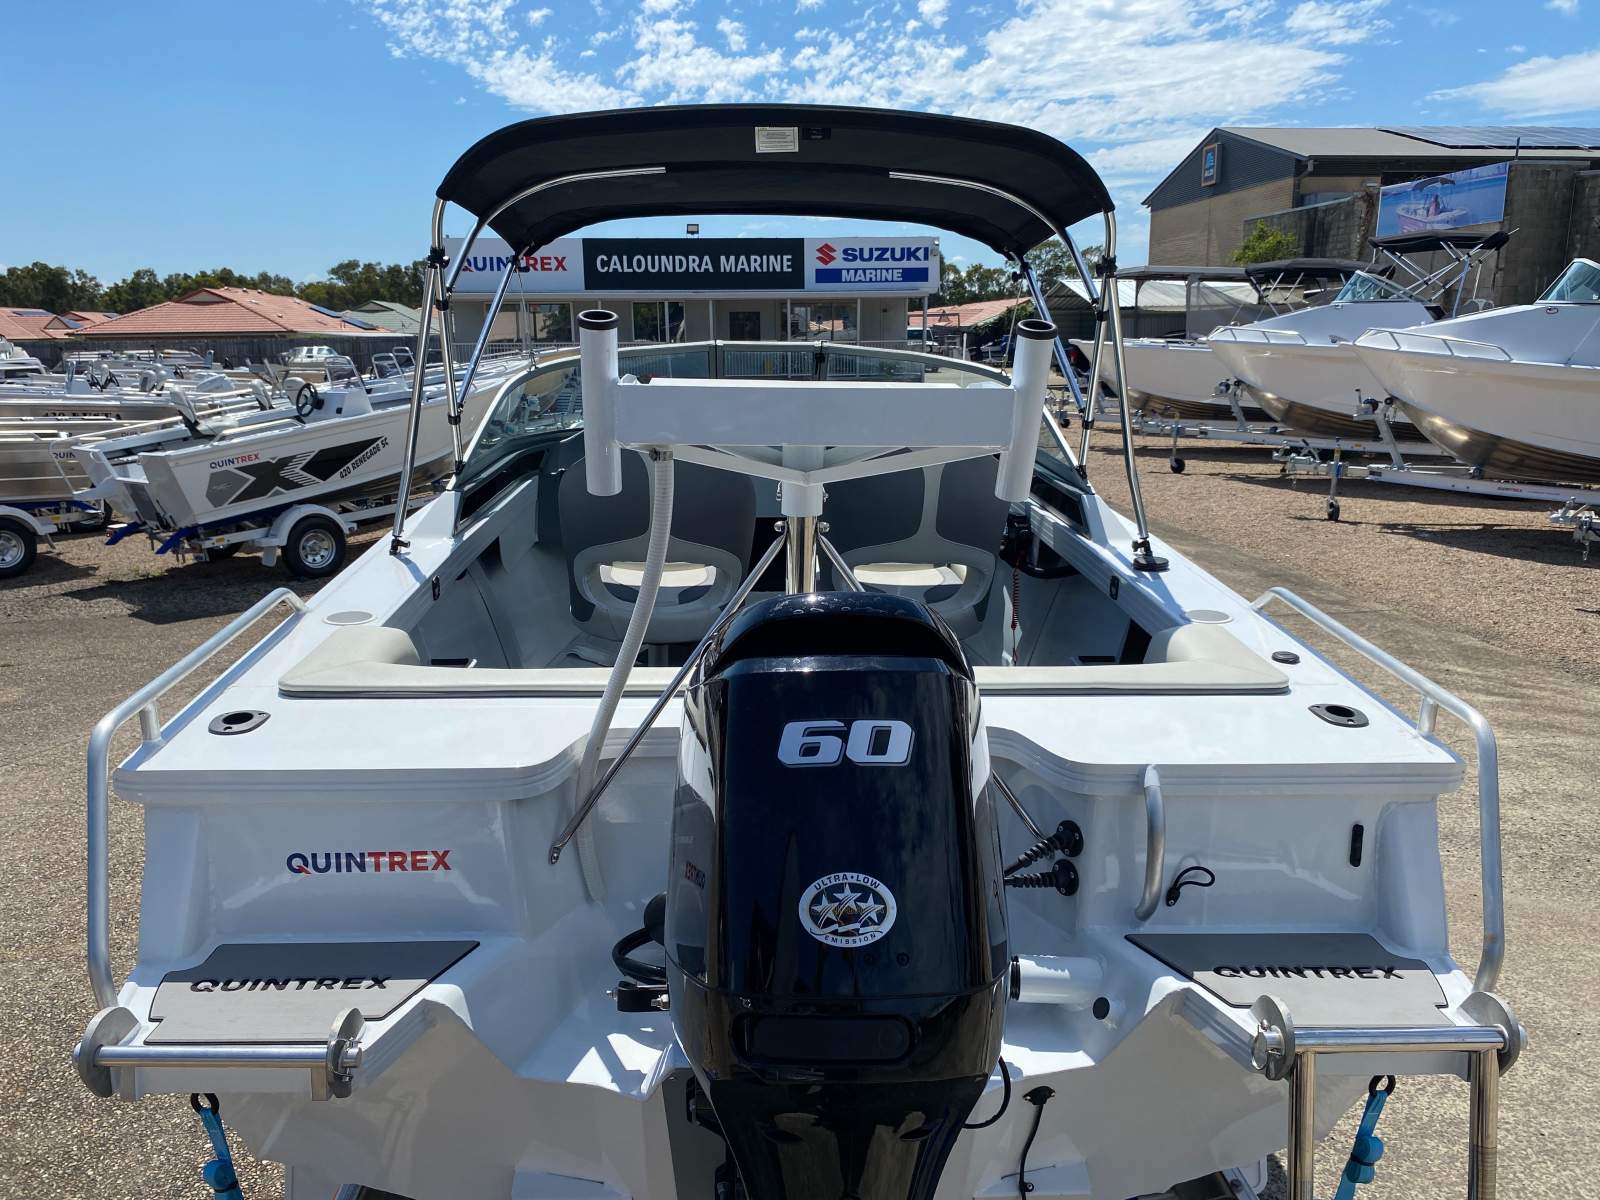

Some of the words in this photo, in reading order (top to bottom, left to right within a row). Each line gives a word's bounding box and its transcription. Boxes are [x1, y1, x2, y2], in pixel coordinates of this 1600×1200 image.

[841, 246, 929, 262] SUZUKI
[596, 254, 714, 273] CALOUNDRA
[719, 254, 793, 273] MARINE
[841, 269, 902, 282] MARINE
[209, 453, 260, 469] QUINTREX
[340, 465, 352, 479] 420
[351, 443, 381, 471] RENEGADE
[777, 720, 915, 768] 60
[286, 850, 452, 874] QUINTREX
[824, 933, 877, 945] EMISSION
[1212, 966, 1405, 980] QUINTREX
[190, 976, 392, 993] QUINTREX
